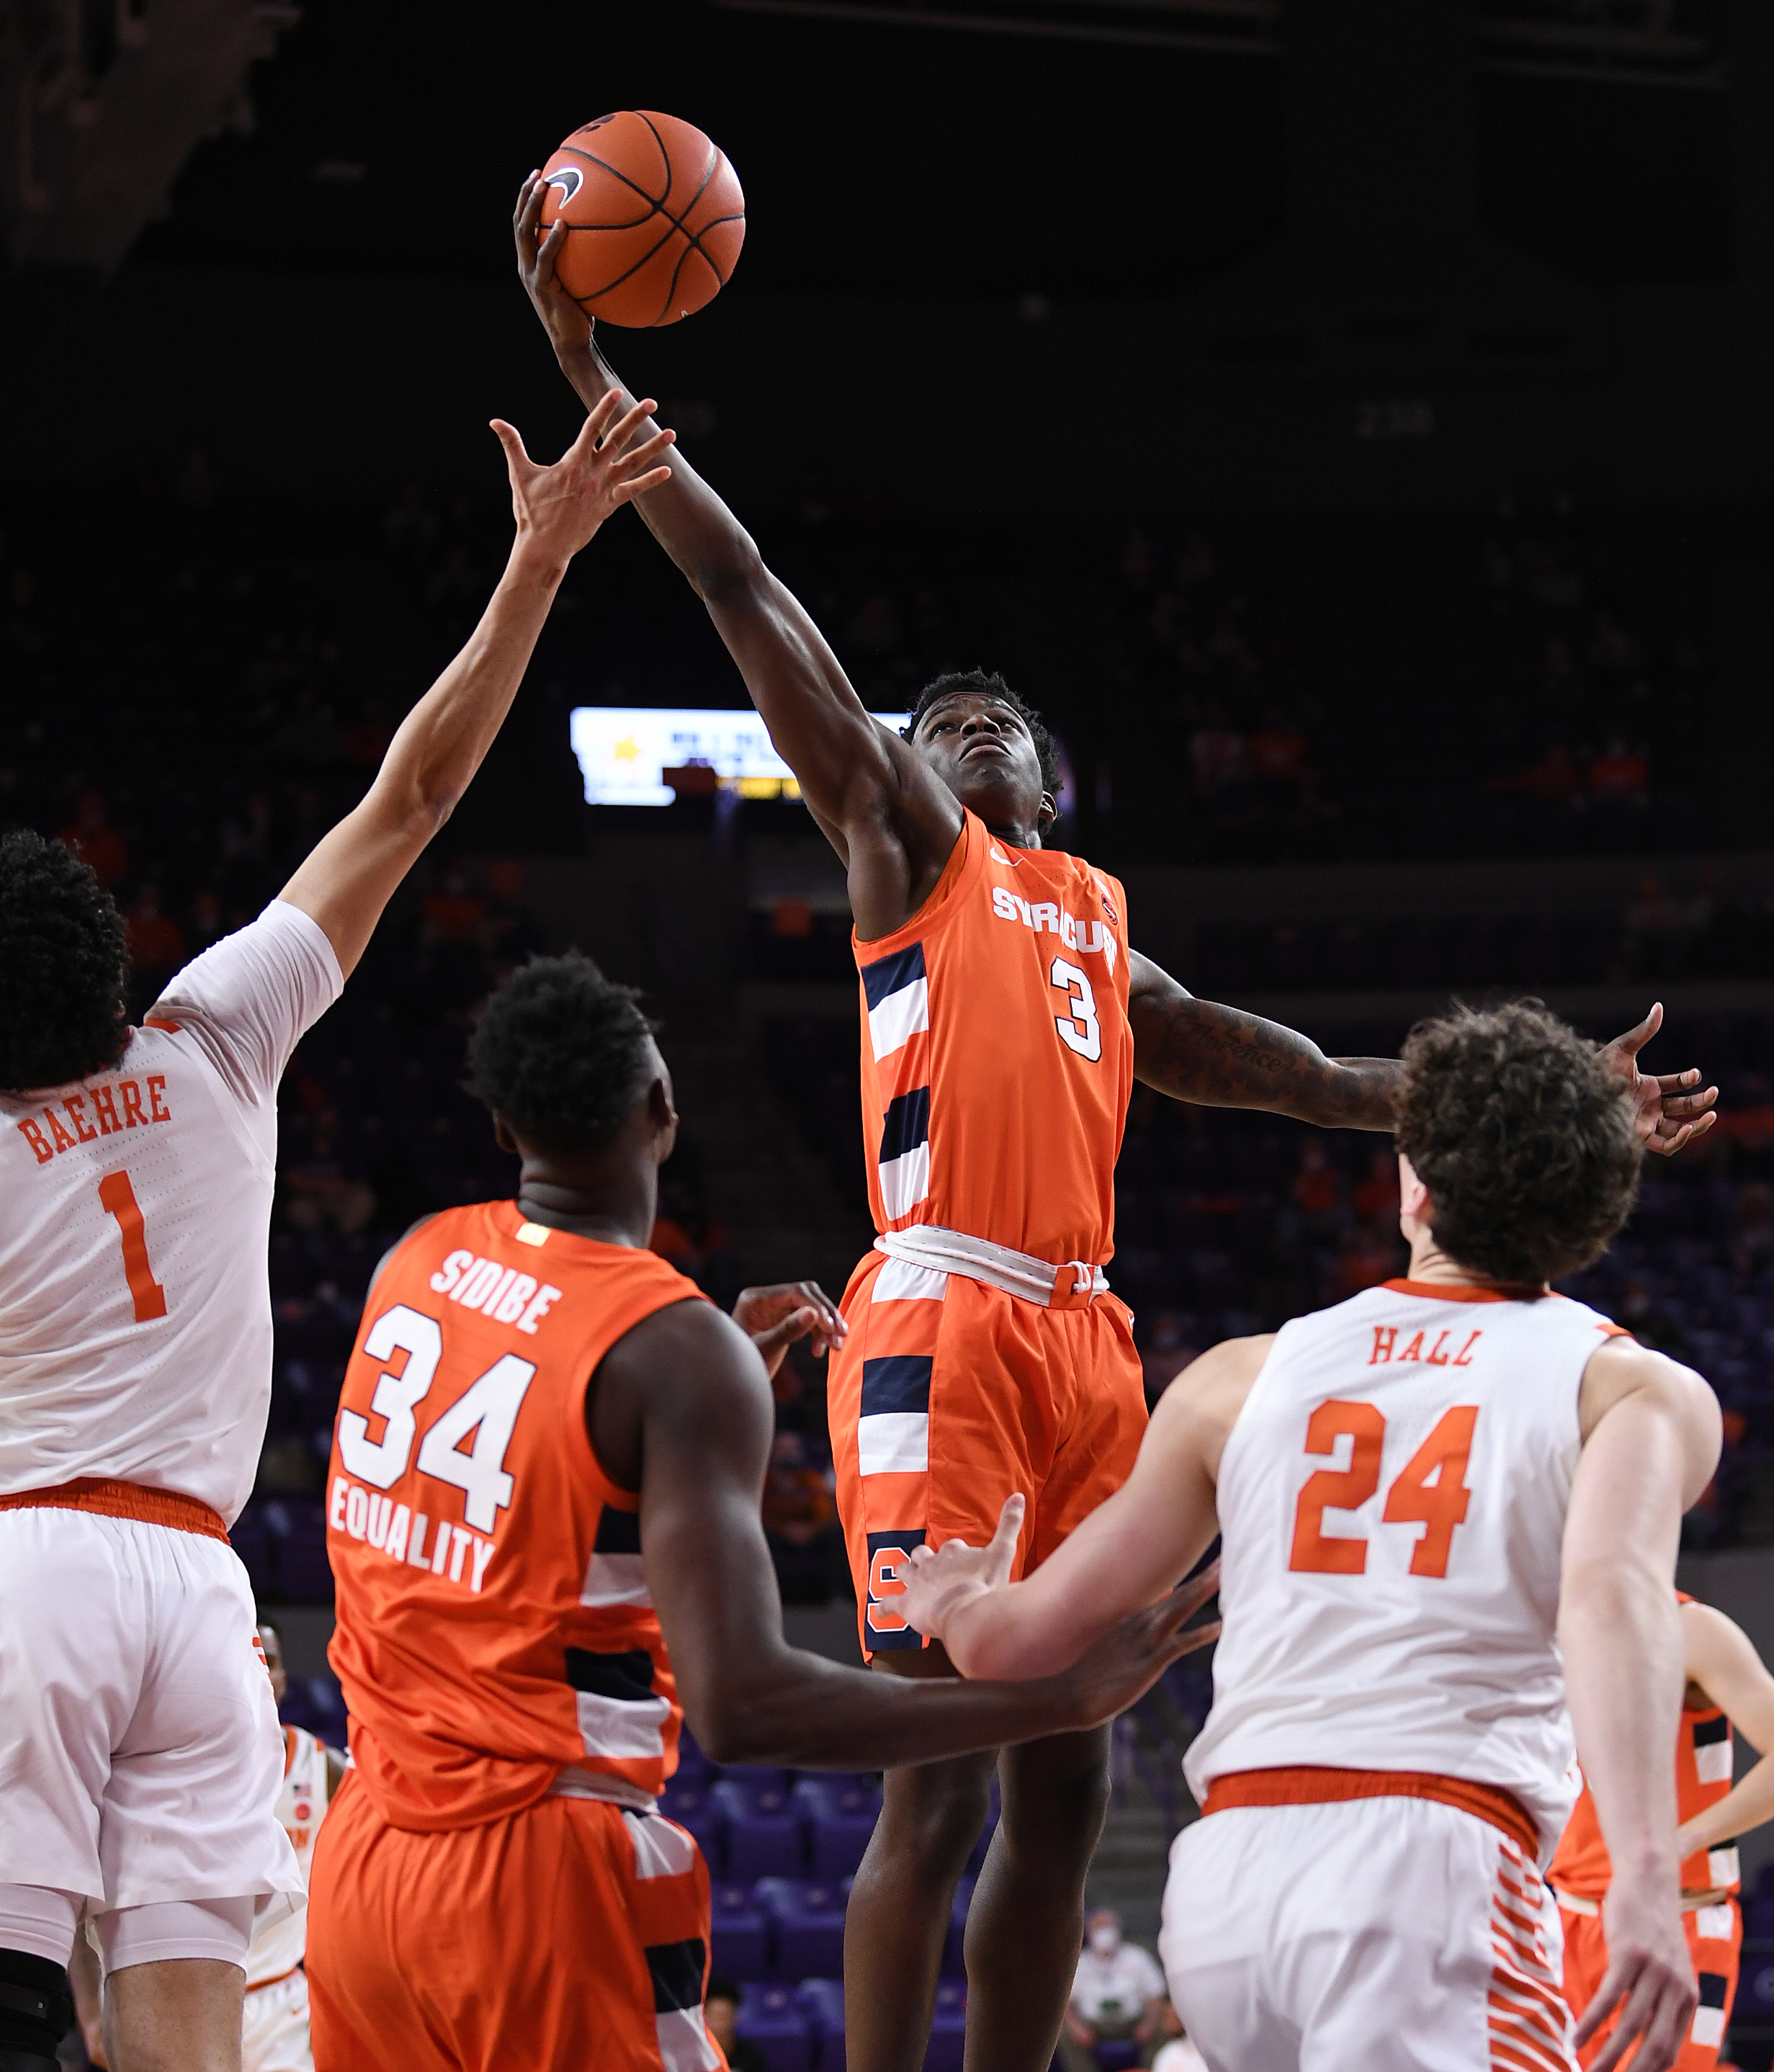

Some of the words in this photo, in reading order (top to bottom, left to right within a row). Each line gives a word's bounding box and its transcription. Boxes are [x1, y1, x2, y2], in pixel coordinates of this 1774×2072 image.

[1051, 956, 1102, 1063] 3
[18, 1075, 171, 1164] BAEHRE
[98, 1170, 167, 1322] 1
[430, 1249, 563, 1335] SIDIBE
[1368, 1327, 1483, 1365] HALL
[338, 1304, 537, 1535] 34
[330, 1476, 496, 1593] EQUALITY
[1289, 1399, 1479, 1579] 24
[867, 1547, 912, 1633] S
